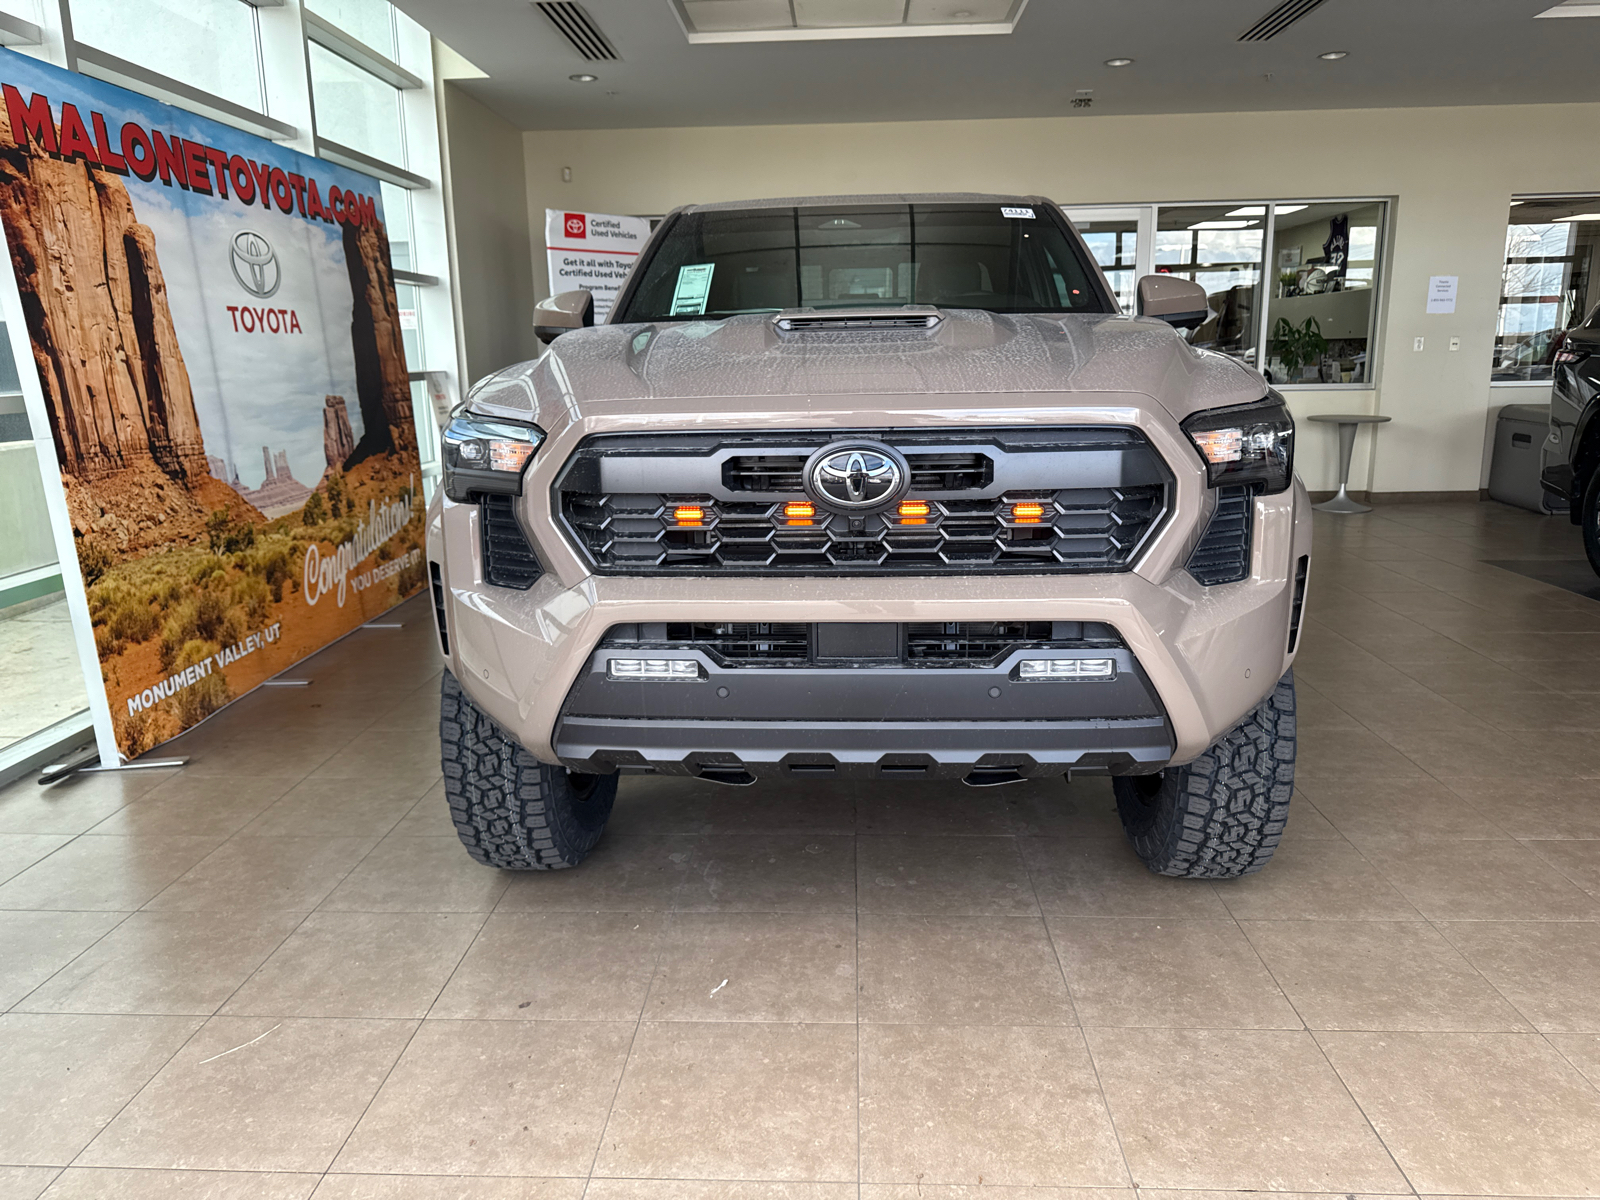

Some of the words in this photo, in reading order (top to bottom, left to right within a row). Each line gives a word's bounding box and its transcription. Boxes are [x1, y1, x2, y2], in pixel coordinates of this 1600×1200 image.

[2, 83, 379, 227] MALONETOYOTA.COM
[591, 219, 621, 229] Certified
[591, 229, 609, 238] Used
[610, 230, 637, 240] Vehicles
[563, 257, 578, 267] Get
[579, 258, 585, 267] it
[586, 259, 597, 268] all
[597, 259, 614, 268] with
[615, 261, 634, 271] Toyo
[559, 268, 593, 278] Certified
[594, 270, 613, 279] Used
[614, 271, 629, 279] Veh
[579, 284, 604, 292] Program
[226, 305, 303, 335] TOYOTA
[350, 571, 372, 594] YOU
[372, 553, 411, 584] DESERVE
[126, 656, 213, 717] MONUMENT
[214, 632, 266, 669] VALLEY,
[264, 622, 281, 643] UT
